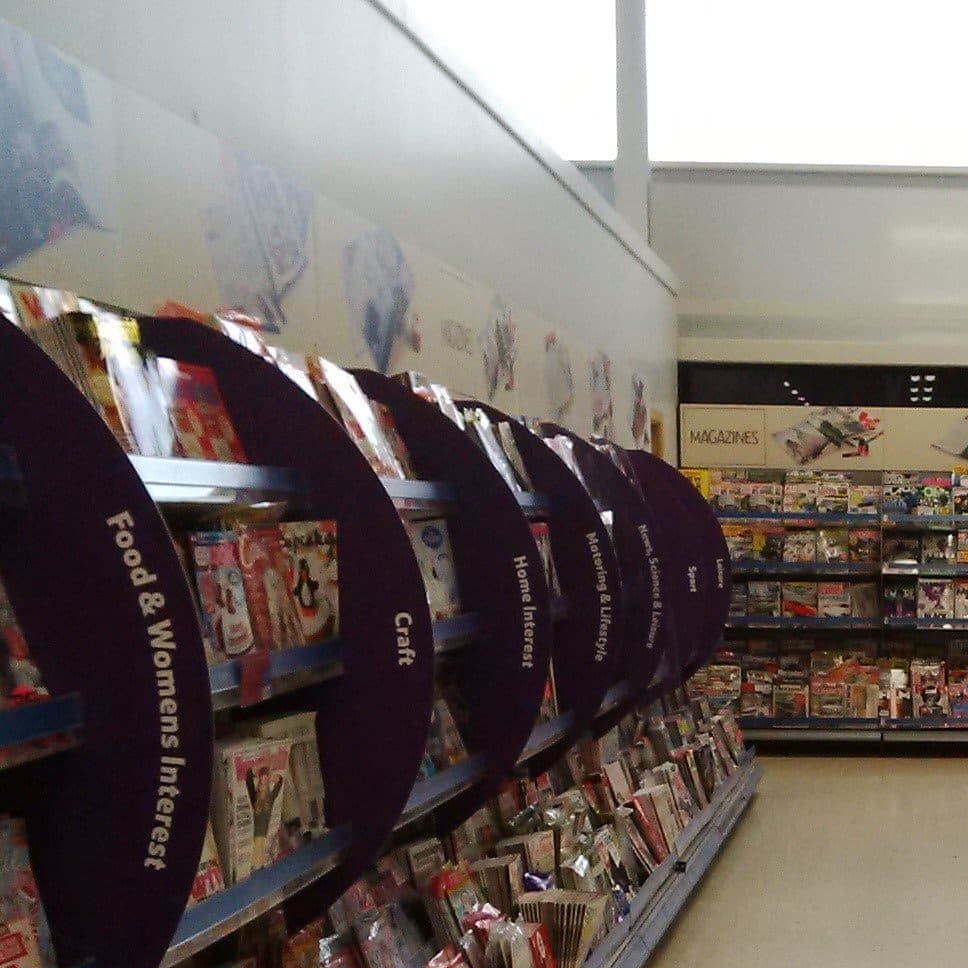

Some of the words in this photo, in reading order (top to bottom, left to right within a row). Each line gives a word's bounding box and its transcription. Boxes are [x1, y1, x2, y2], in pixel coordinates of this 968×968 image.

[689, 430, 759, 444] MAGAZINES
[106, 509, 157, 588] Food
[586, 531, 608, 592] Motoring
[138, 592, 165, 617] &
[513, 555, 532, 603] Home
[600, 593, 611, 605] &
[687, 565, 697, 593] Sport
[394, 612, 417, 667] Craft
[521, 606, 537, 669] Interest
[595, 606, 612, 662] Lifestyle
[147, 618, 181, 750] Womens
[144, 756, 187, 871] Interest
